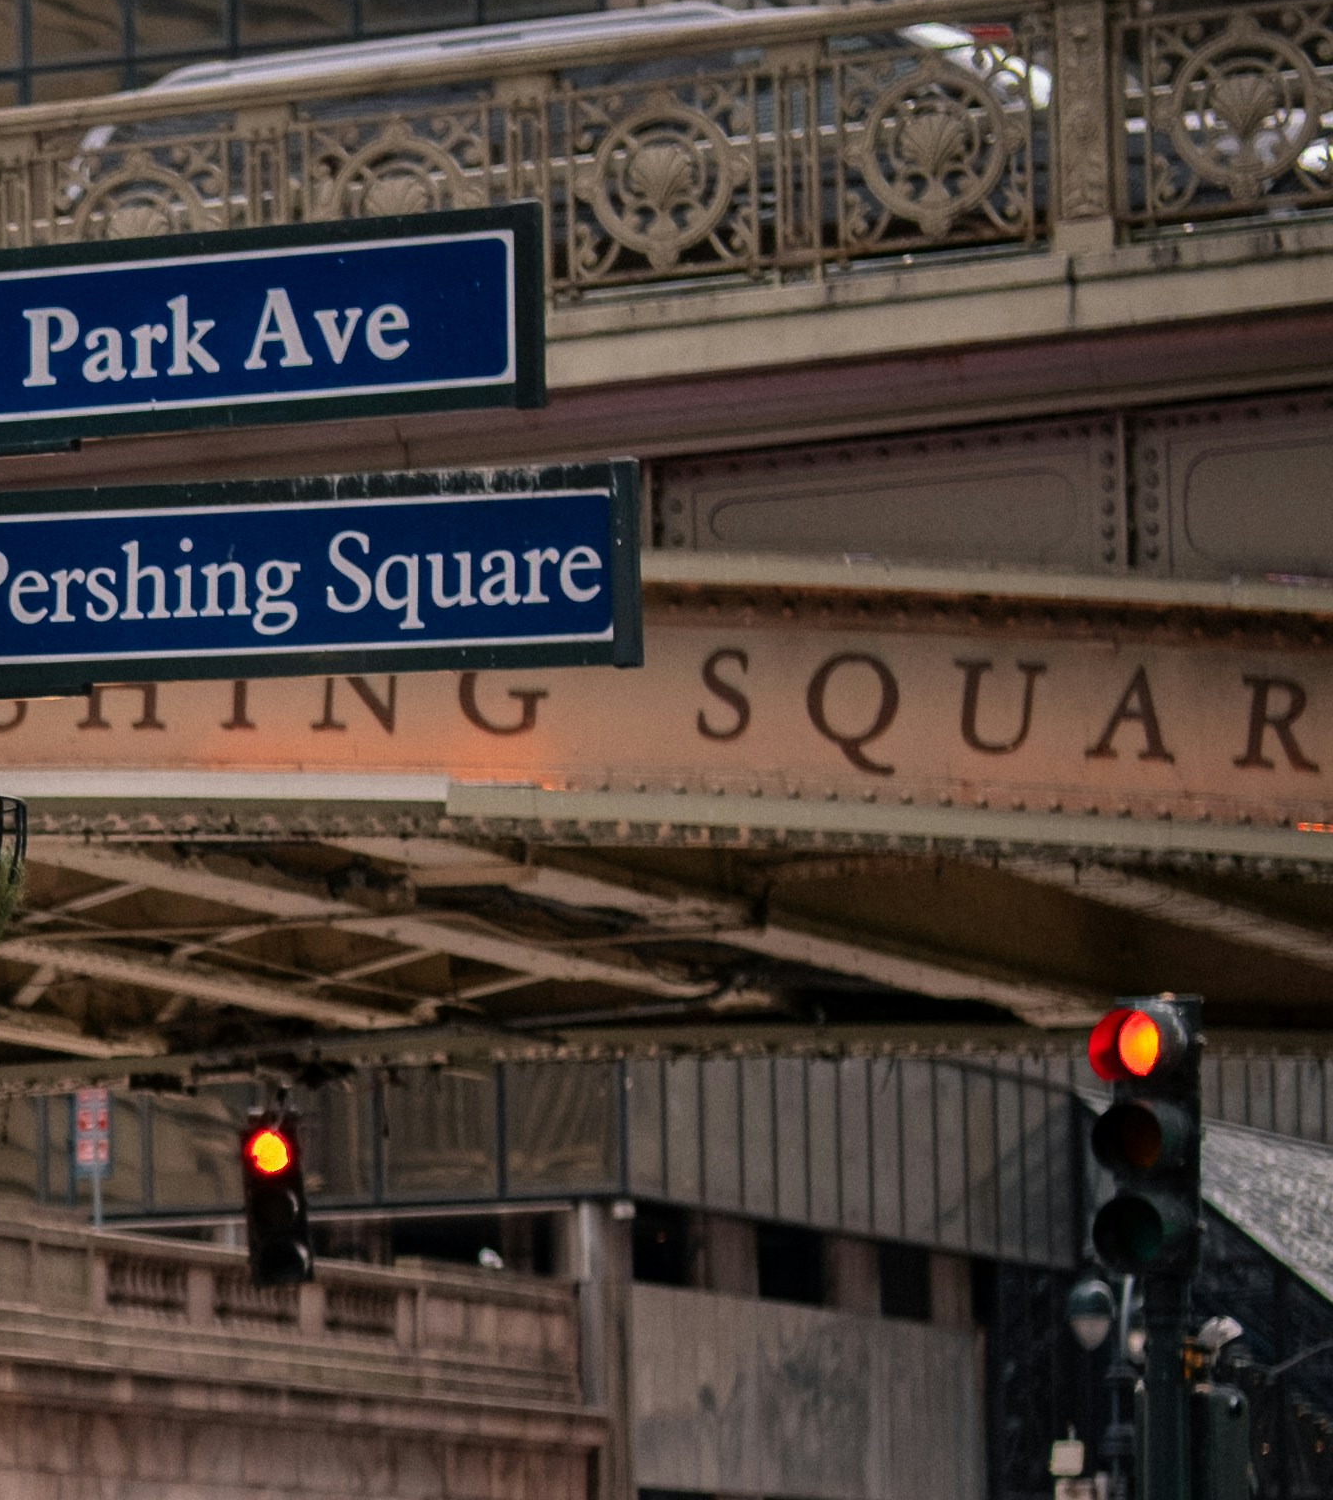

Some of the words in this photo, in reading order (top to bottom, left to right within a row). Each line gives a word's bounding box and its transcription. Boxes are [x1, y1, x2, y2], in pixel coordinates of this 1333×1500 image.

[21, 294, 221, 389] Park
[242, 288, 412, 370] Ave
[325, 529, 604, 630] Square
[697, 647, 1320, 776] SQUAR
